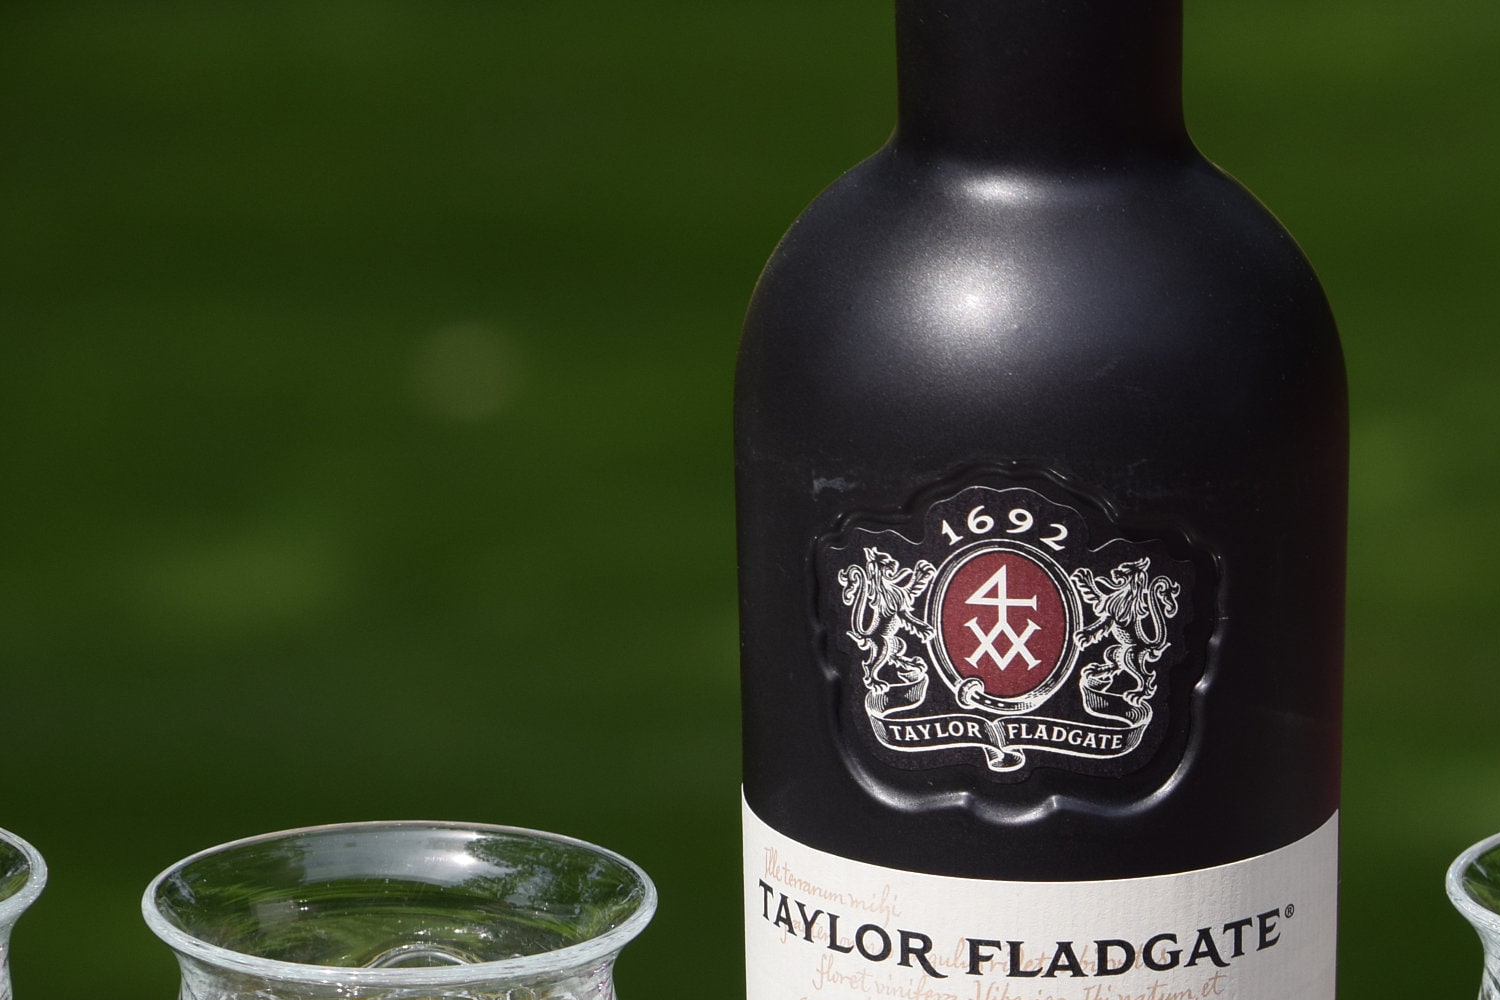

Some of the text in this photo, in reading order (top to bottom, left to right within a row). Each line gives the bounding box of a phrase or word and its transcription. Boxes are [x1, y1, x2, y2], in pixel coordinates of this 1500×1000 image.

[941, 505, 1069, 551] 1692
[889, 721, 1123, 750] TAYLOR FLADGATE
[759, 878, 948, 978] TAYLOR
